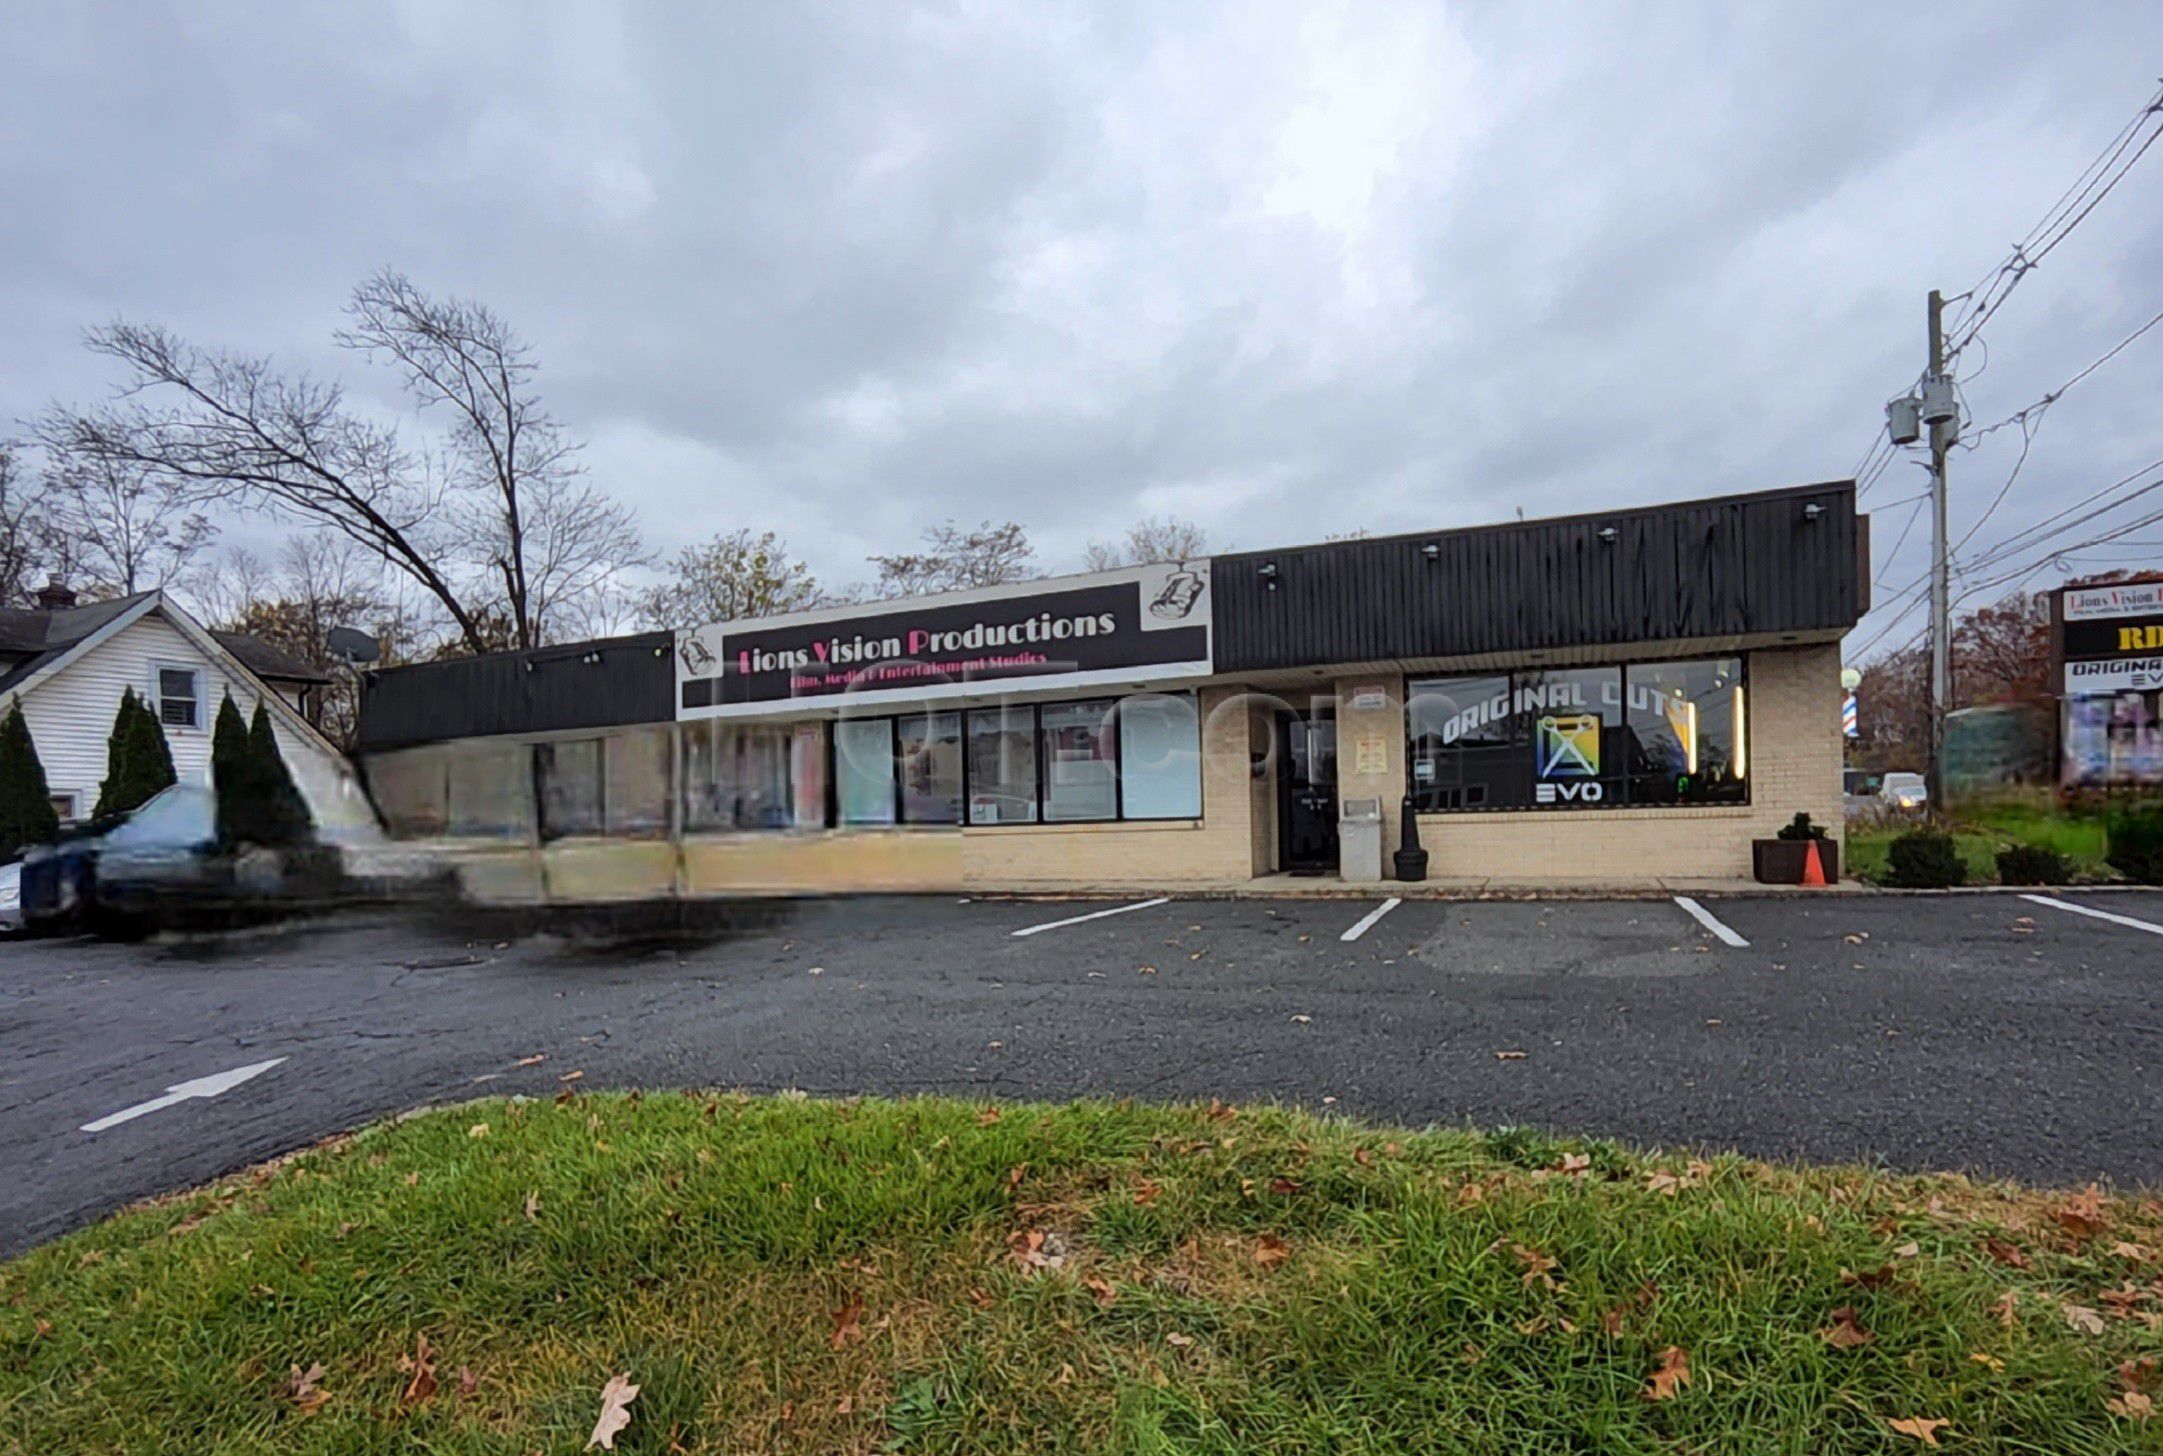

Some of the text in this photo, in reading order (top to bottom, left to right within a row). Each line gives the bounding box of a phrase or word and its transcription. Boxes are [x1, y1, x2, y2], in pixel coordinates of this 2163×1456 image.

[2111, 591, 2152, 606] Vision
[739, 613, 1115, 674] Lions Vision Productions
[879, 658, 985, 680] Entertainment
[1442, 683, 1586, 744] ORIGINAL
[1535, 782, 1602, 802] EVO
